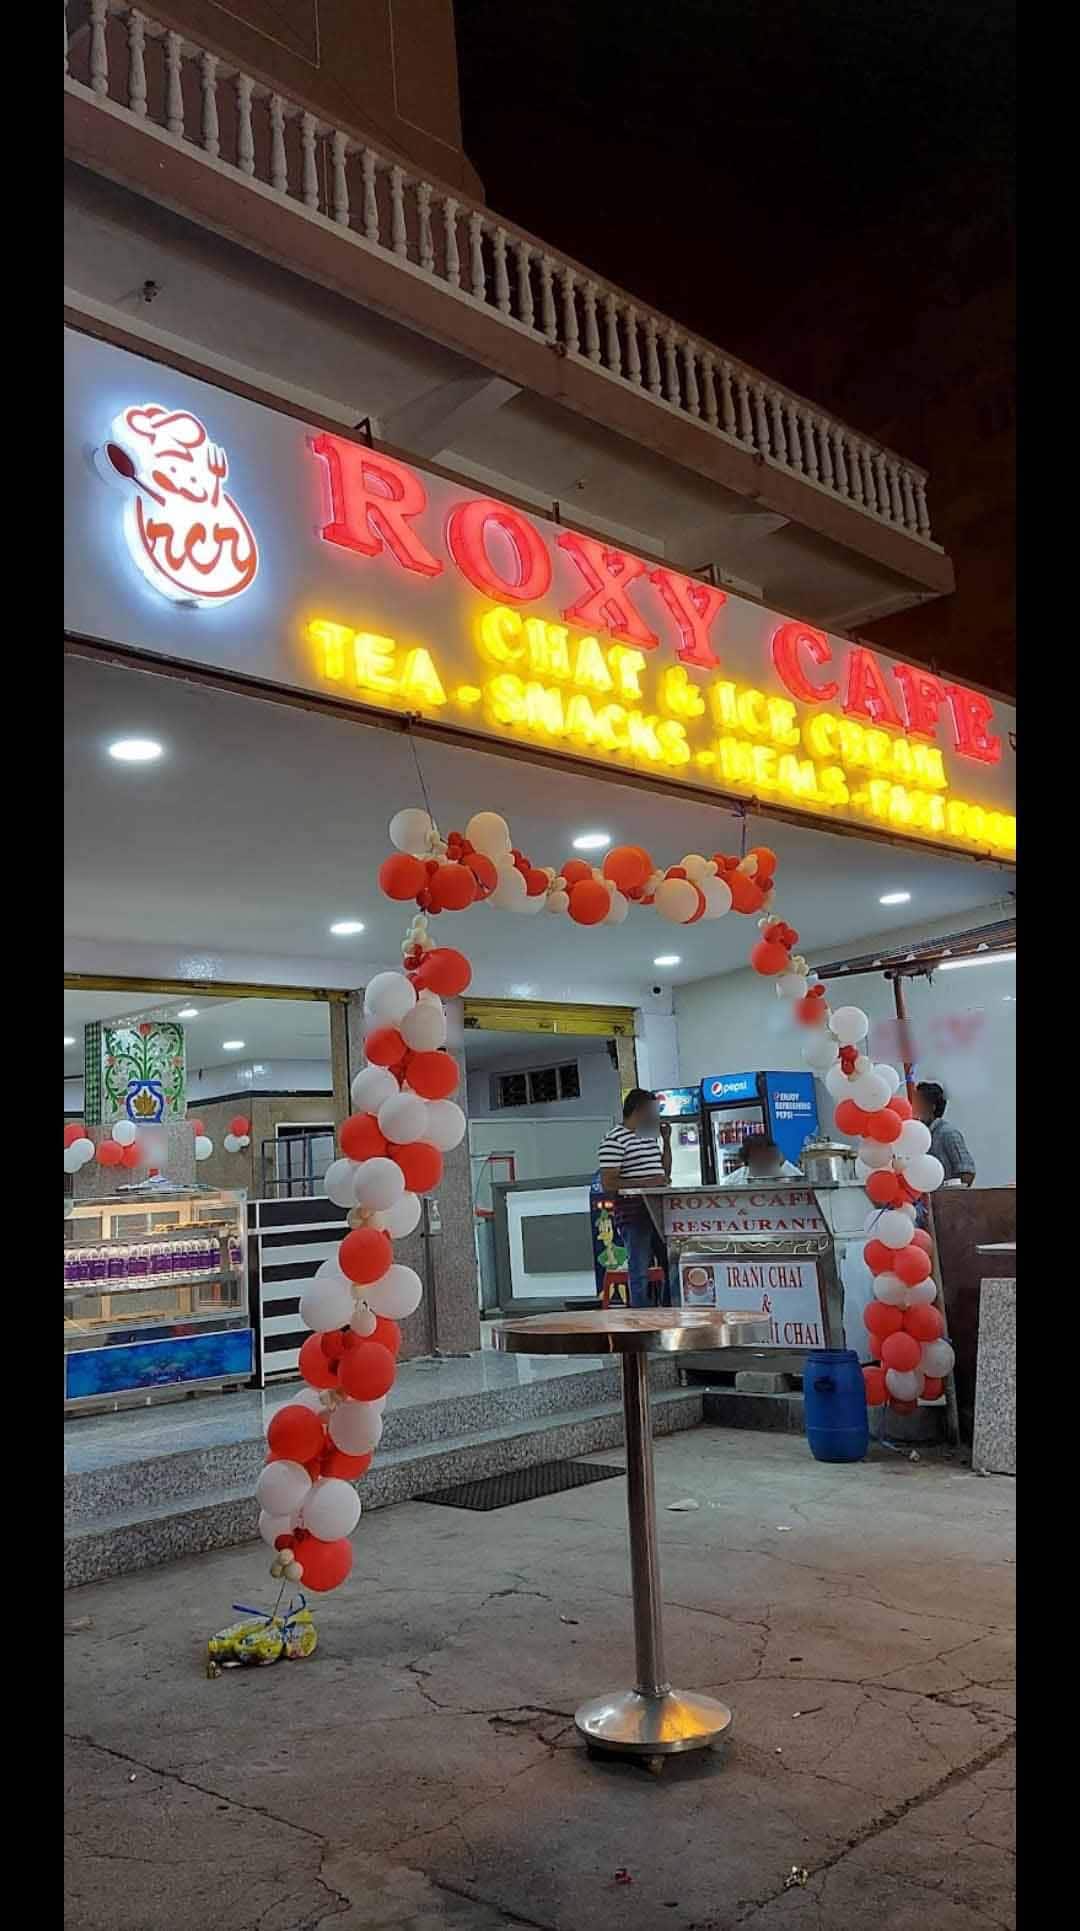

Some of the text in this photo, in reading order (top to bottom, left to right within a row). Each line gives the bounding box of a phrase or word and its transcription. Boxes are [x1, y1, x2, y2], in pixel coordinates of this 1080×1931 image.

[310, 432, 1001, 765] ROXY CAFE
[481, 606, 647, 700] CHAT
[713, 681, 801, 746] ICE
[308, 618, 448, 706] TEA
[488, 673, 691, 767] SNACKS
[717, 736, 850, 805] MEALS
[722, 1080, 748, 1095] pepsi
[670, 1194, 737, 1211] ROXY
[671, 1217, 824, 1234] RESTAURANT
[727, 1265, 804, 1289] IRANI CHAI
[761, 1293, 773, 1314] &
[783, 1322, 821, 1345] CHAI
